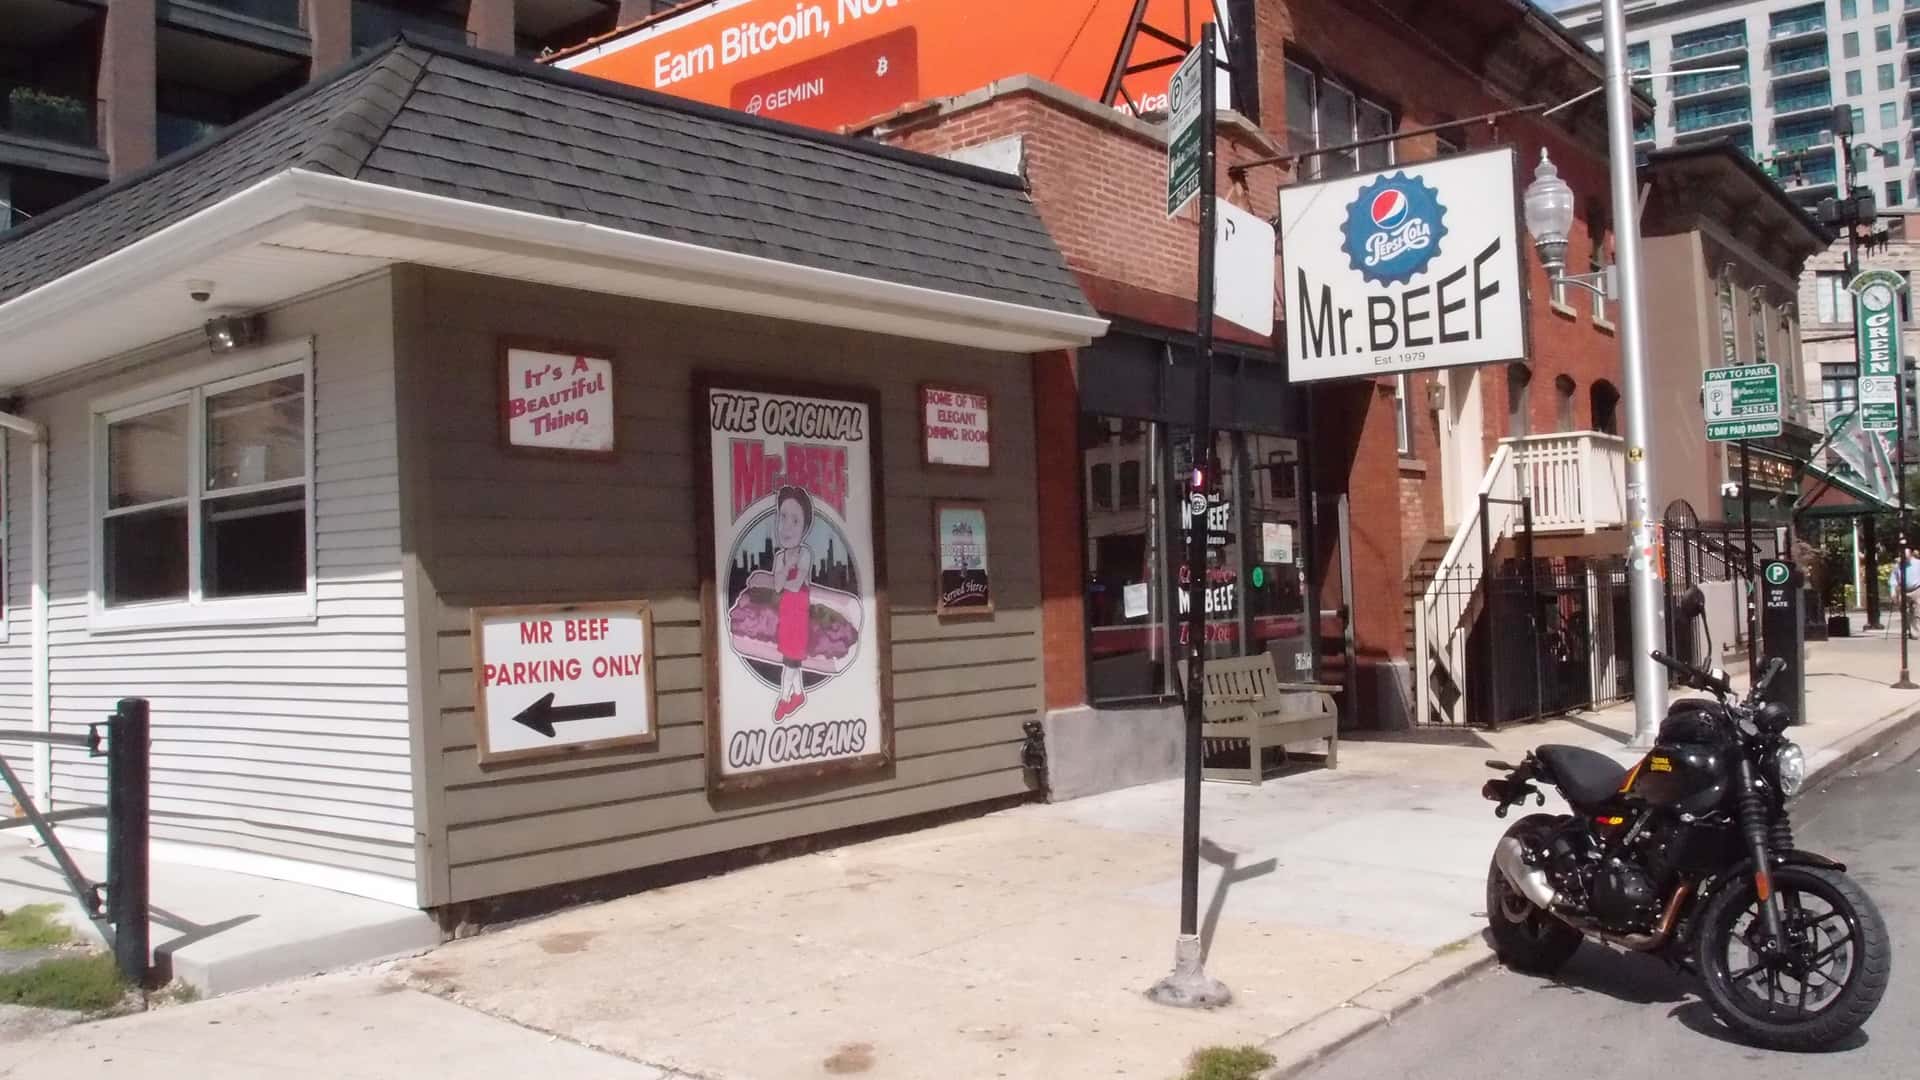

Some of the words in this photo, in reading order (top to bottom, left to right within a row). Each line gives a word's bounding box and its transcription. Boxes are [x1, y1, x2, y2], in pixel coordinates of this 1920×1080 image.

[654, 43, 714, 88] Earn
[721, 5, 830, 65] Bitcoin,
[837, 0, 899, 25] No
[766, 78, 824, 111] GEMINI
[1367, 235, 1501, 352] BEEF
[1400, 351, 1426, 362] 1979
[1866, 312, 1891, 374] GREEN
[571, 354, 589, 376] A
[1709, 371, 1727, 380] PAY
[1729, 369, 1743, 378] TO
[1744, 366, 1772, 377] PARK
[927, 391, 953, 407] HOME
[955, 394, 967, 408] OF
[970, 397, 986, 409] THE
[711, 393, 759, 432] THE
[762, 399, 863, 441] ORIGINAL
[937, 409, 977, 425] ELEGANT
[1714, 427, 1729, 436] DAY
[1747, 421, 1778, 433] PARKING
[927, 426, 959, 440] DINING
[961, 428, 990, 443] ROOM
[784, 441, 849, 522] BEEF
[1207, 502, 1230, 531] EEF
[1205, 584, 1234, 613] BEEF
[520, 621, 553, 645] MR
[565, 618, 609, 642] BEEF
[483, 658, 582, 687] PARKING
[593, 654, 642, 678] ONLY
[728, 729, 767, 768] ON
[768, 718, 867, 763] ORLEANS
